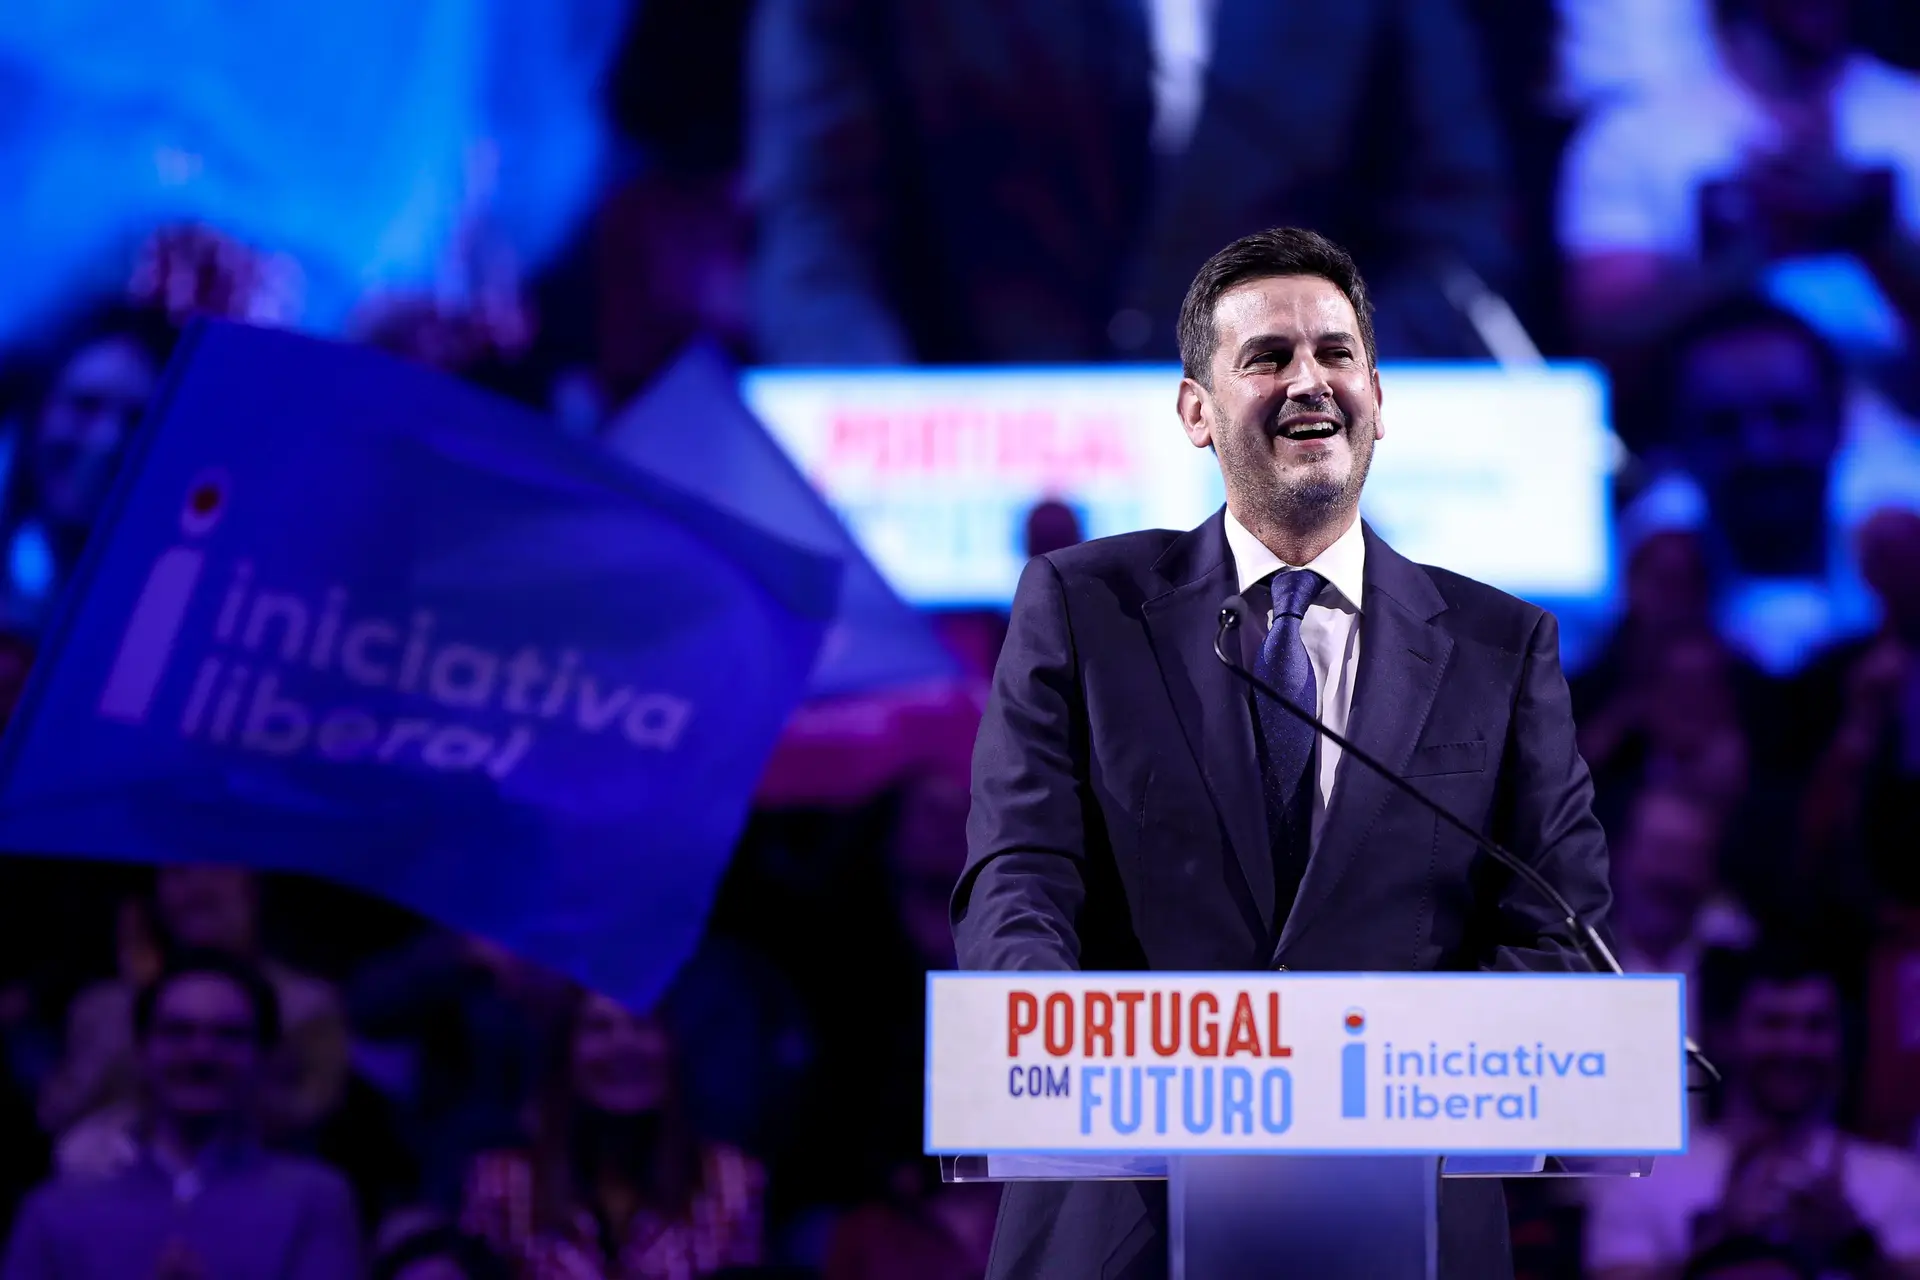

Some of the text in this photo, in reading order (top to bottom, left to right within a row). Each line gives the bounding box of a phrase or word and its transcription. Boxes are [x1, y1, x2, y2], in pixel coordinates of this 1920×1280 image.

[215, 560, 693, 751] iniciativa
[181, 656, 532, 779] liberal
[1008, 991, 1292, 1058] PORTUGAL
[1384, 1042, 1605, 1077] iniciativa
[1008, 1066, 1292, 1134] COM FUTURO
[1384, 1084, 1538, 1119] liberal
